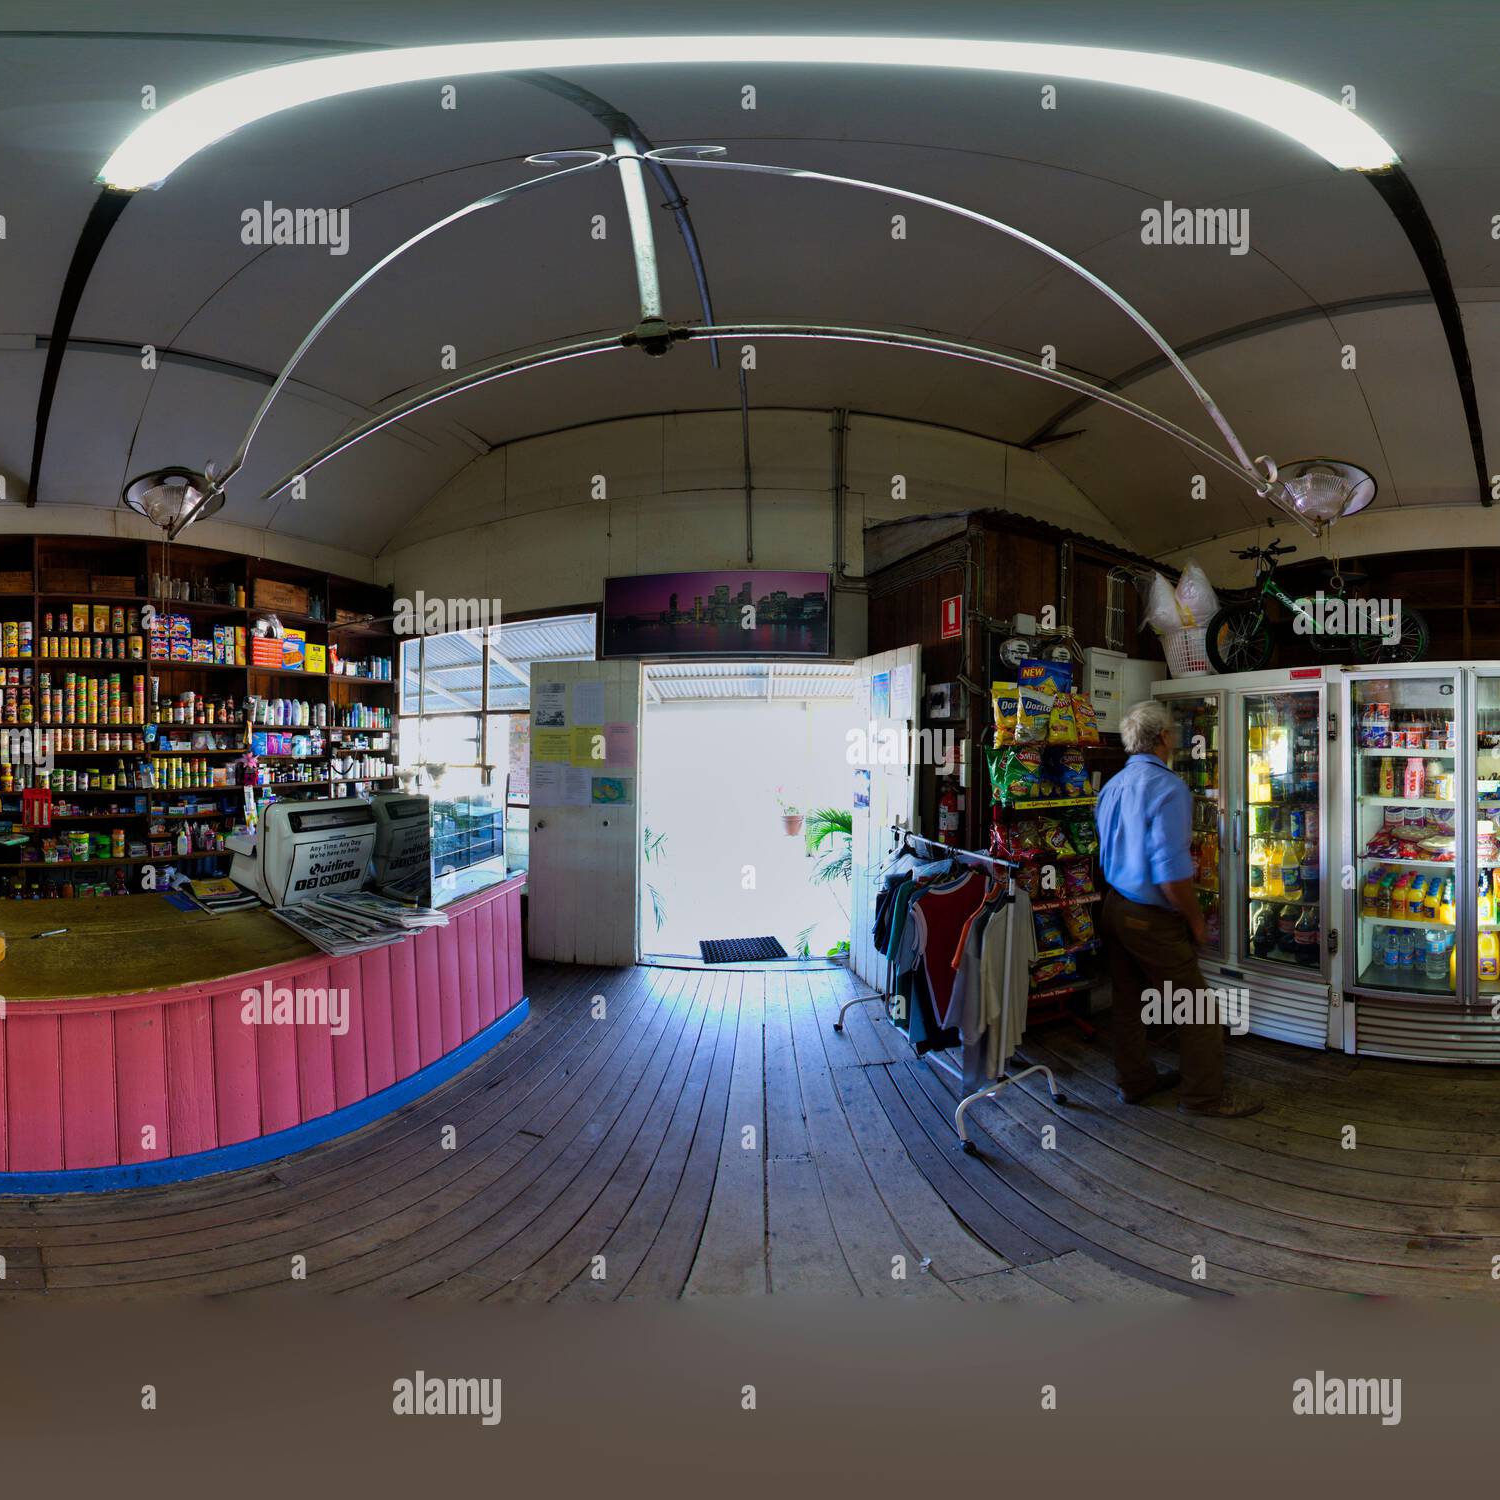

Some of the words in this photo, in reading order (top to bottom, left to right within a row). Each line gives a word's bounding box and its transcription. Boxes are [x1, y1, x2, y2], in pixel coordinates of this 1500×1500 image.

[1021, 667, 1045, 678] NEW
[1025, 701, 1051, 712] Dorito
[1409, 769, 1417, 792] OAK
[309, 859, 355, 875] Quitline
